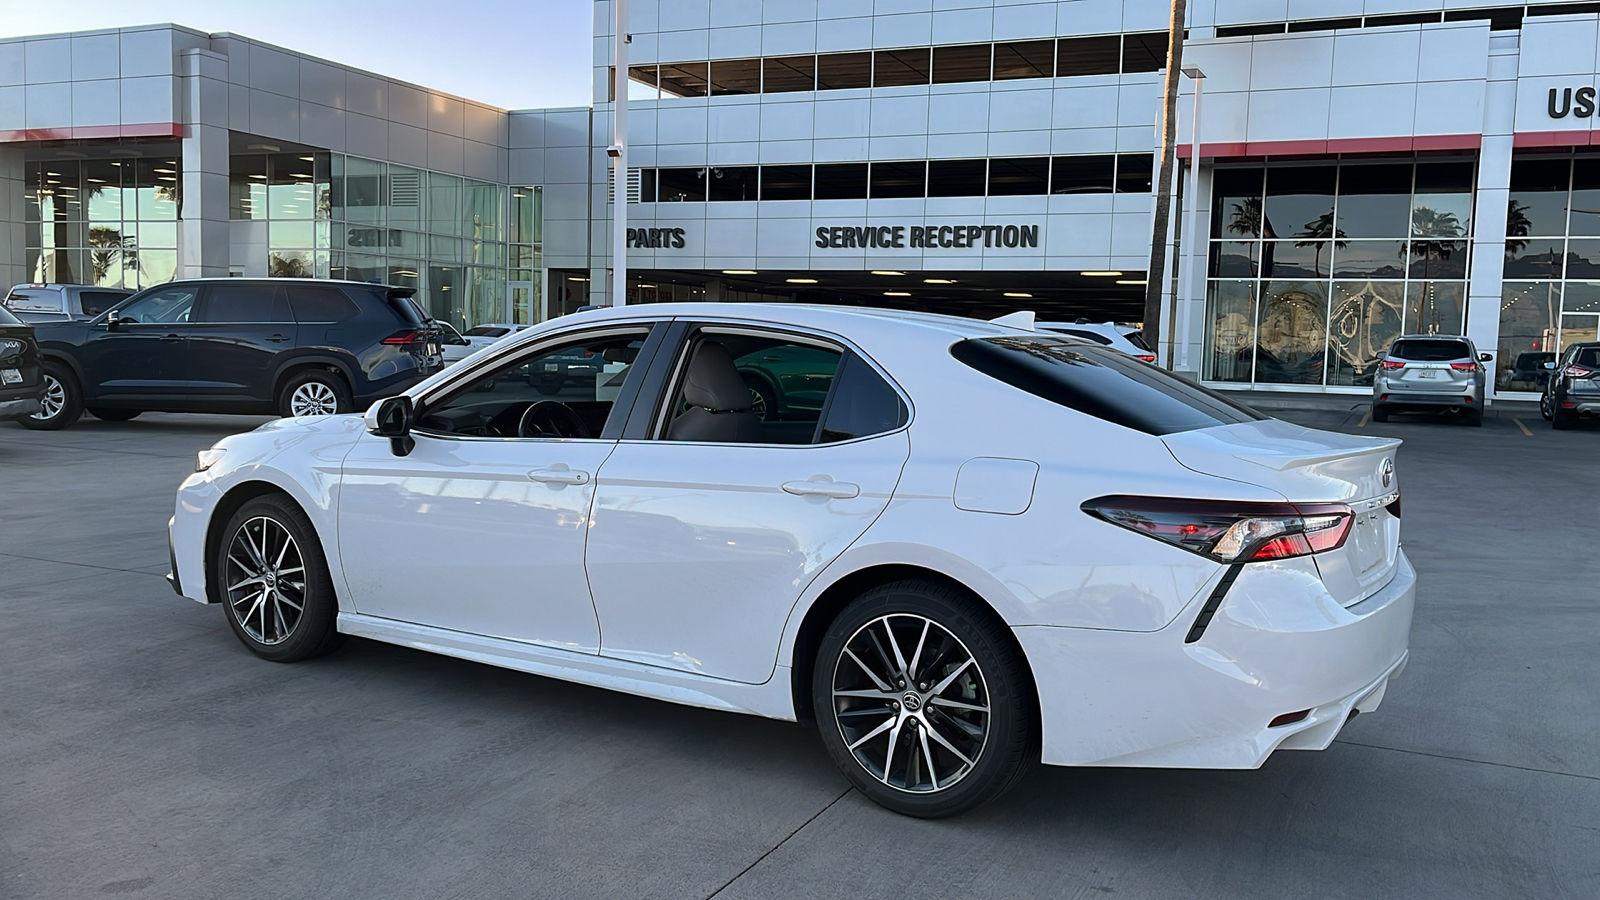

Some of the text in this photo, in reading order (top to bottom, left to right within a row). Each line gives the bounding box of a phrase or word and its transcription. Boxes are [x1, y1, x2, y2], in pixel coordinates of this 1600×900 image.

[1548, 87, 1600, 119] US
[626, 227, 685, 249] PARTS
[815, 225, 1039, 249] SERVICE RECEPTION
[647, 289, 673, 301] TOOTA
[962, 623, 1004, 690] ADVANTA
